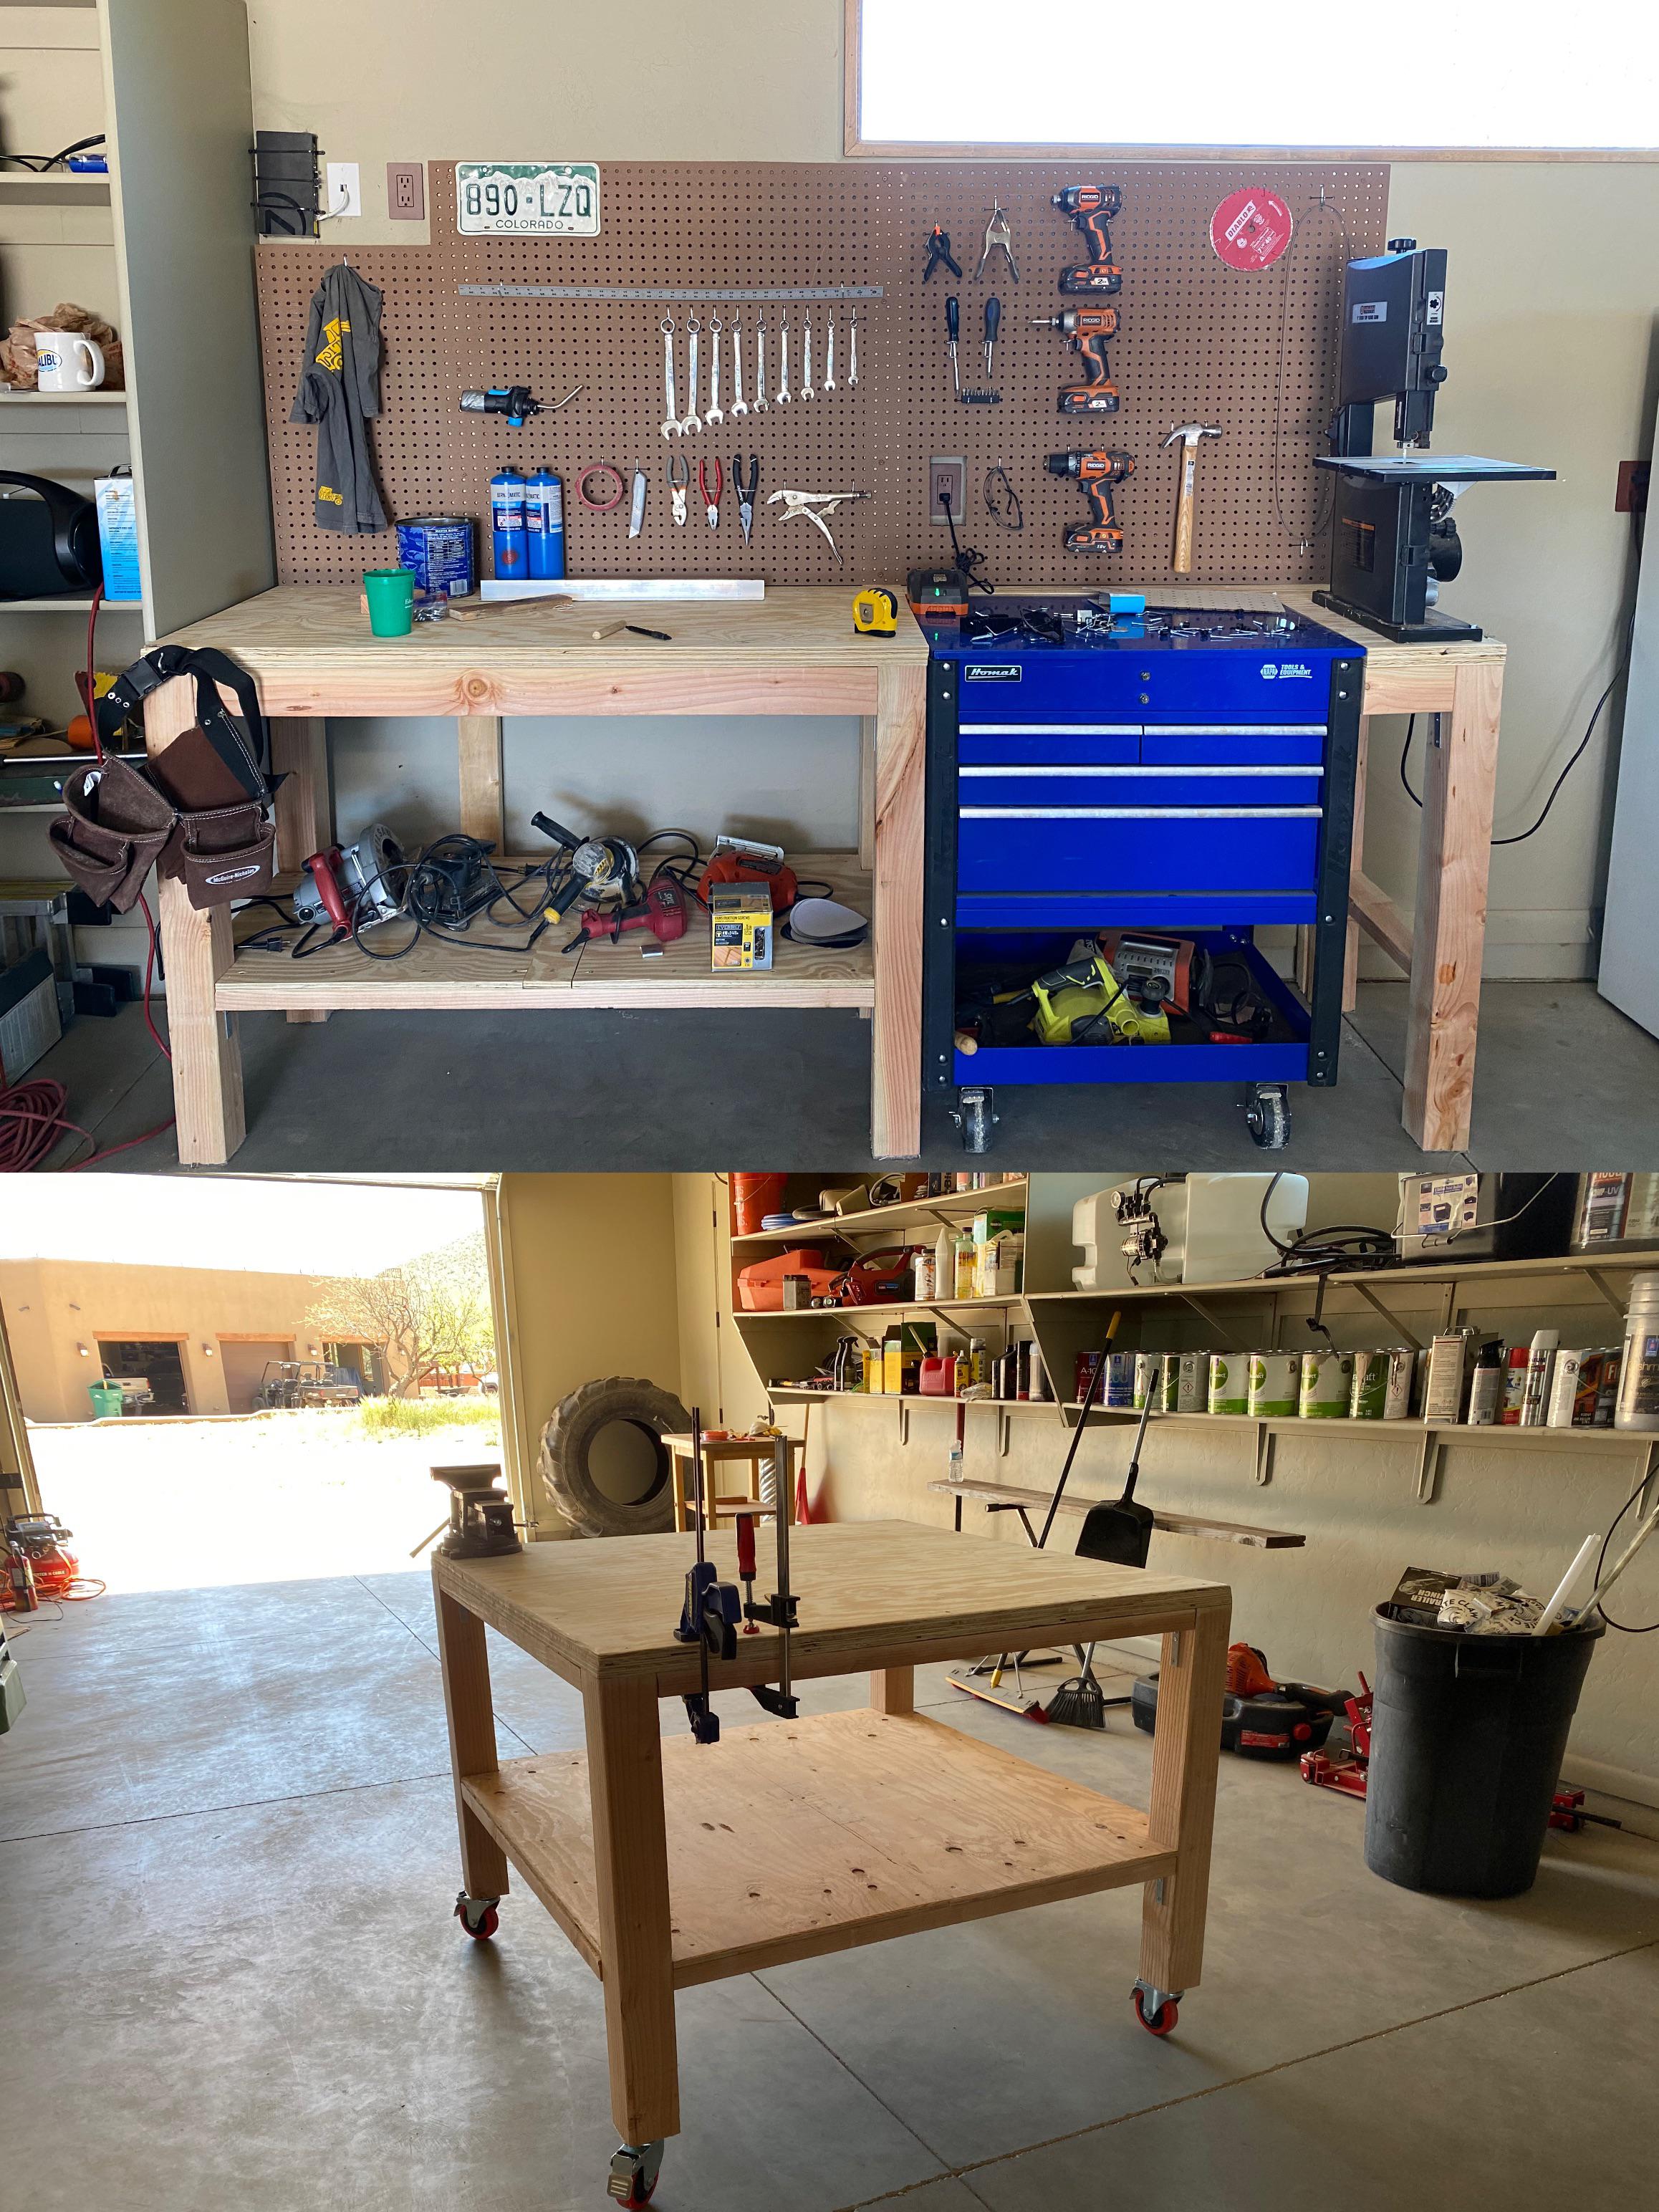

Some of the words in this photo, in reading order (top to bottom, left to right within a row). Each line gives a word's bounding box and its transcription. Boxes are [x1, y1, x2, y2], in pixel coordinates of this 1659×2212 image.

[496, 219, 564, 229] COLORADO
[1228, 211, 1249, 237] DIABLO
[213, 868, 255, 883] McGuire-Nicholas
[1410, 1595, 1443, 1607] RAILER
[1458, 1599, 1479, 1619] CLAW
